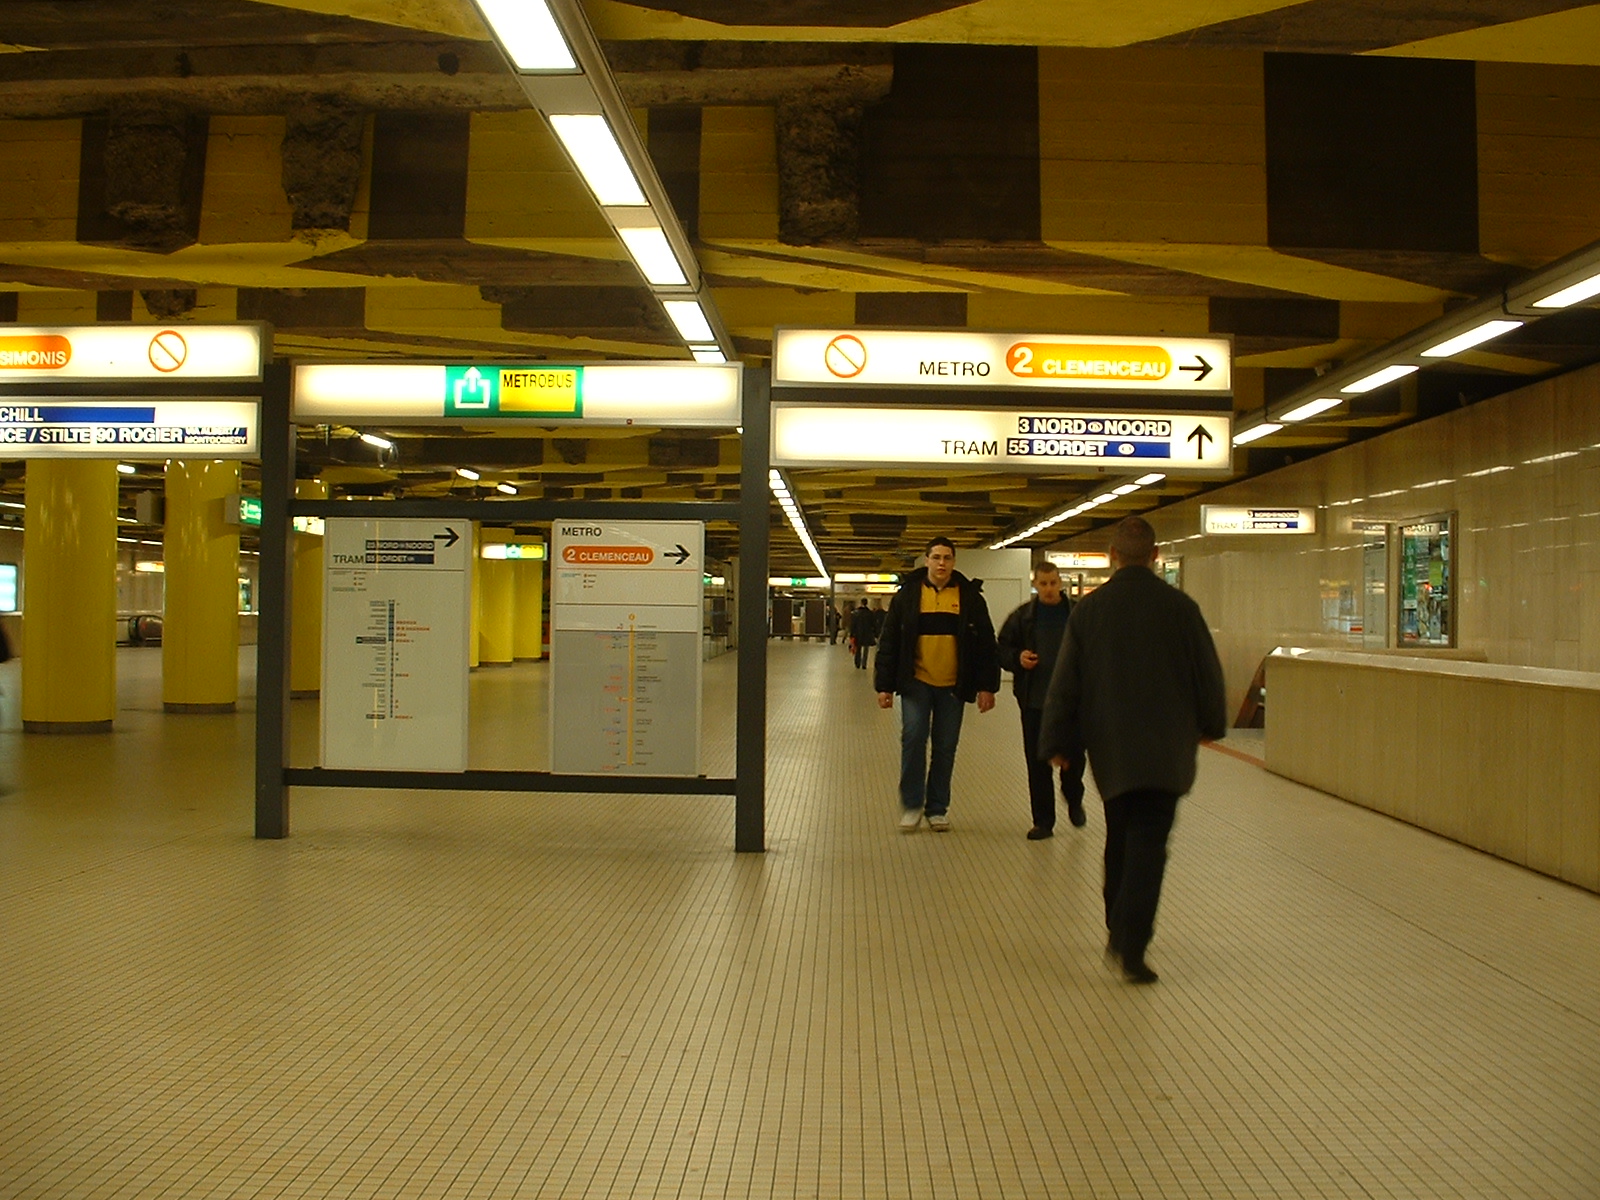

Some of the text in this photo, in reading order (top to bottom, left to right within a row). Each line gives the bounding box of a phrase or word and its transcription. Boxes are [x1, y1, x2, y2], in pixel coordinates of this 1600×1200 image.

[0, 350, 67, 366] SIMONIS
[919, 346, 1167, 377] METRO 2 CLEMENCEAU
[503, 374, 573, 388] METROBUS
[40, 428, 91, 442] STILTE
[96, 427, 183, 442] 90 ROGIER
[1019, 418, 1171, 437] 3 NORD NOORD
[940, 440, 998, 456] TRAM
[1008, 439, 1108, 457] 55 BORDET
[561, 527, 603, 537] METRO
[333, 554, 364, 564] TRAM
[567, 549, 650, 562] 2 CLEMENCEAU
